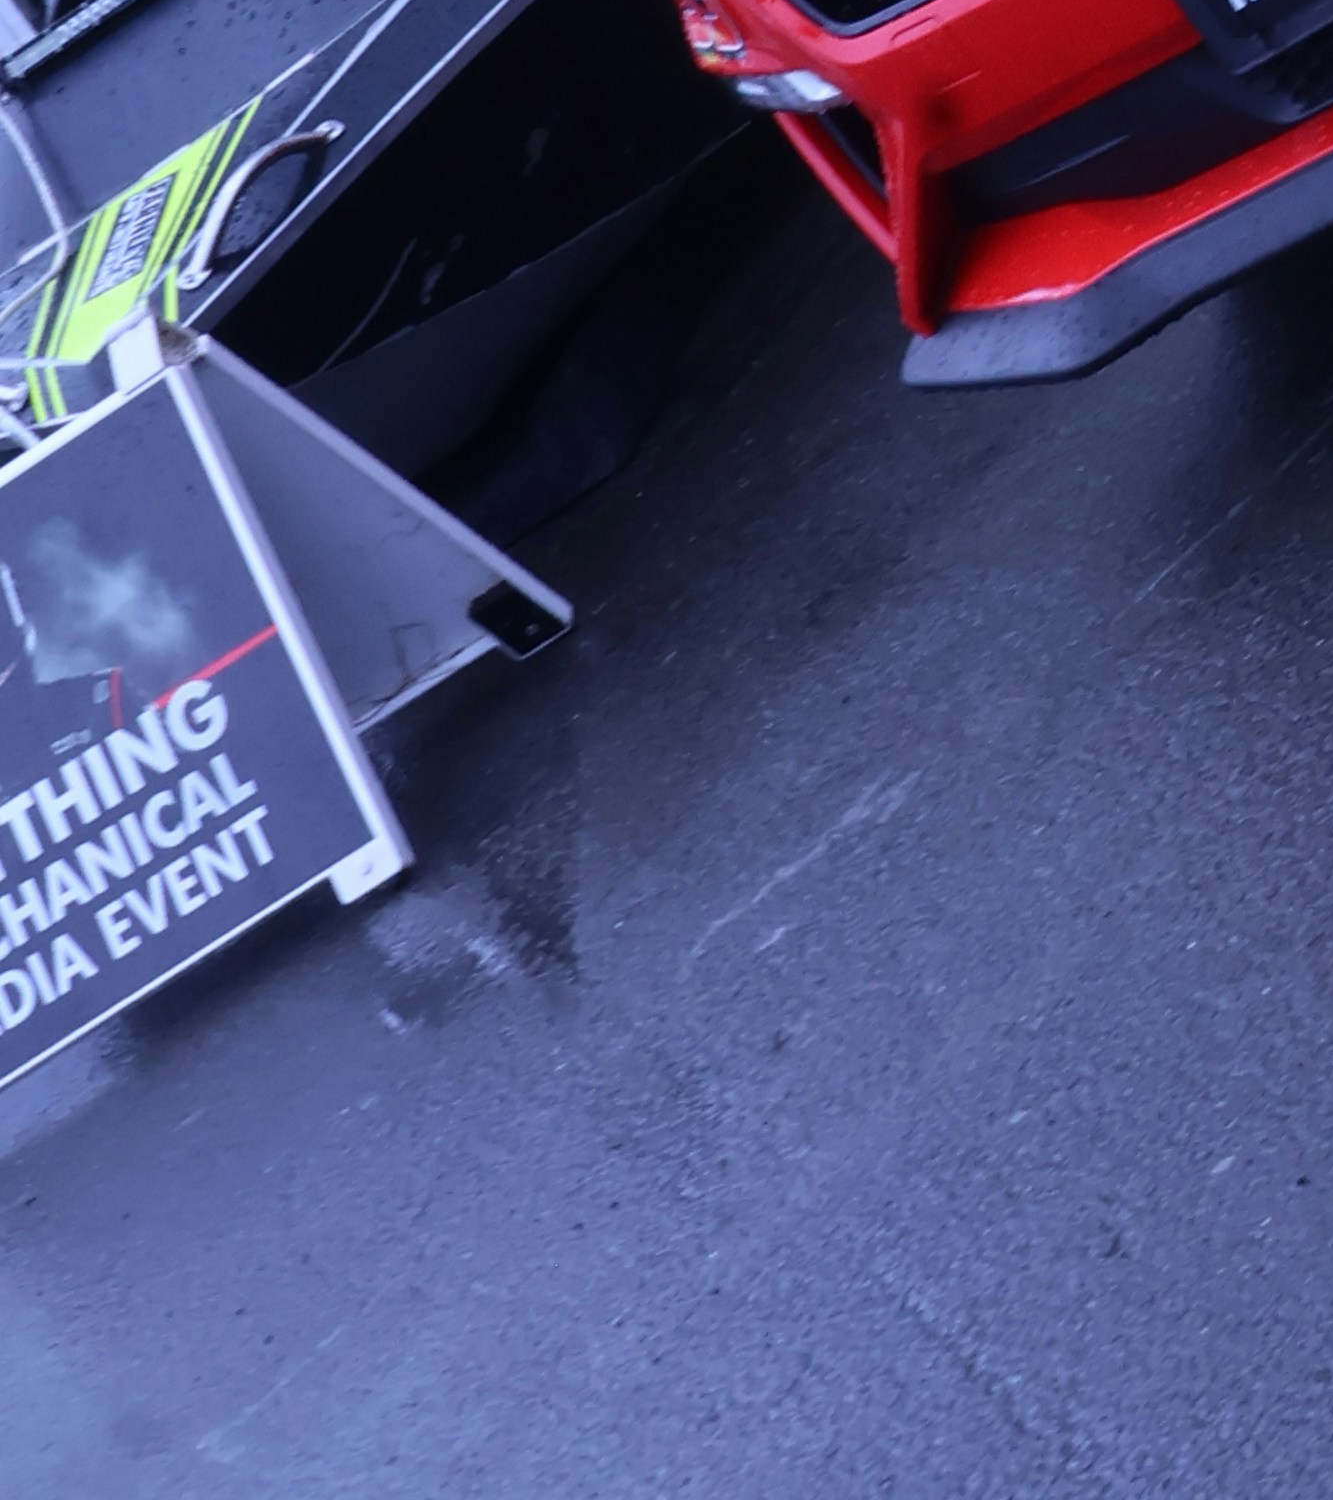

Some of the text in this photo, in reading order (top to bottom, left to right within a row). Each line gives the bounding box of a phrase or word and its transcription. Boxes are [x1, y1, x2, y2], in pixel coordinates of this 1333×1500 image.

[0, 679, 229, 880] THING
[0, 804, 274, 1036] DIA EVENT
